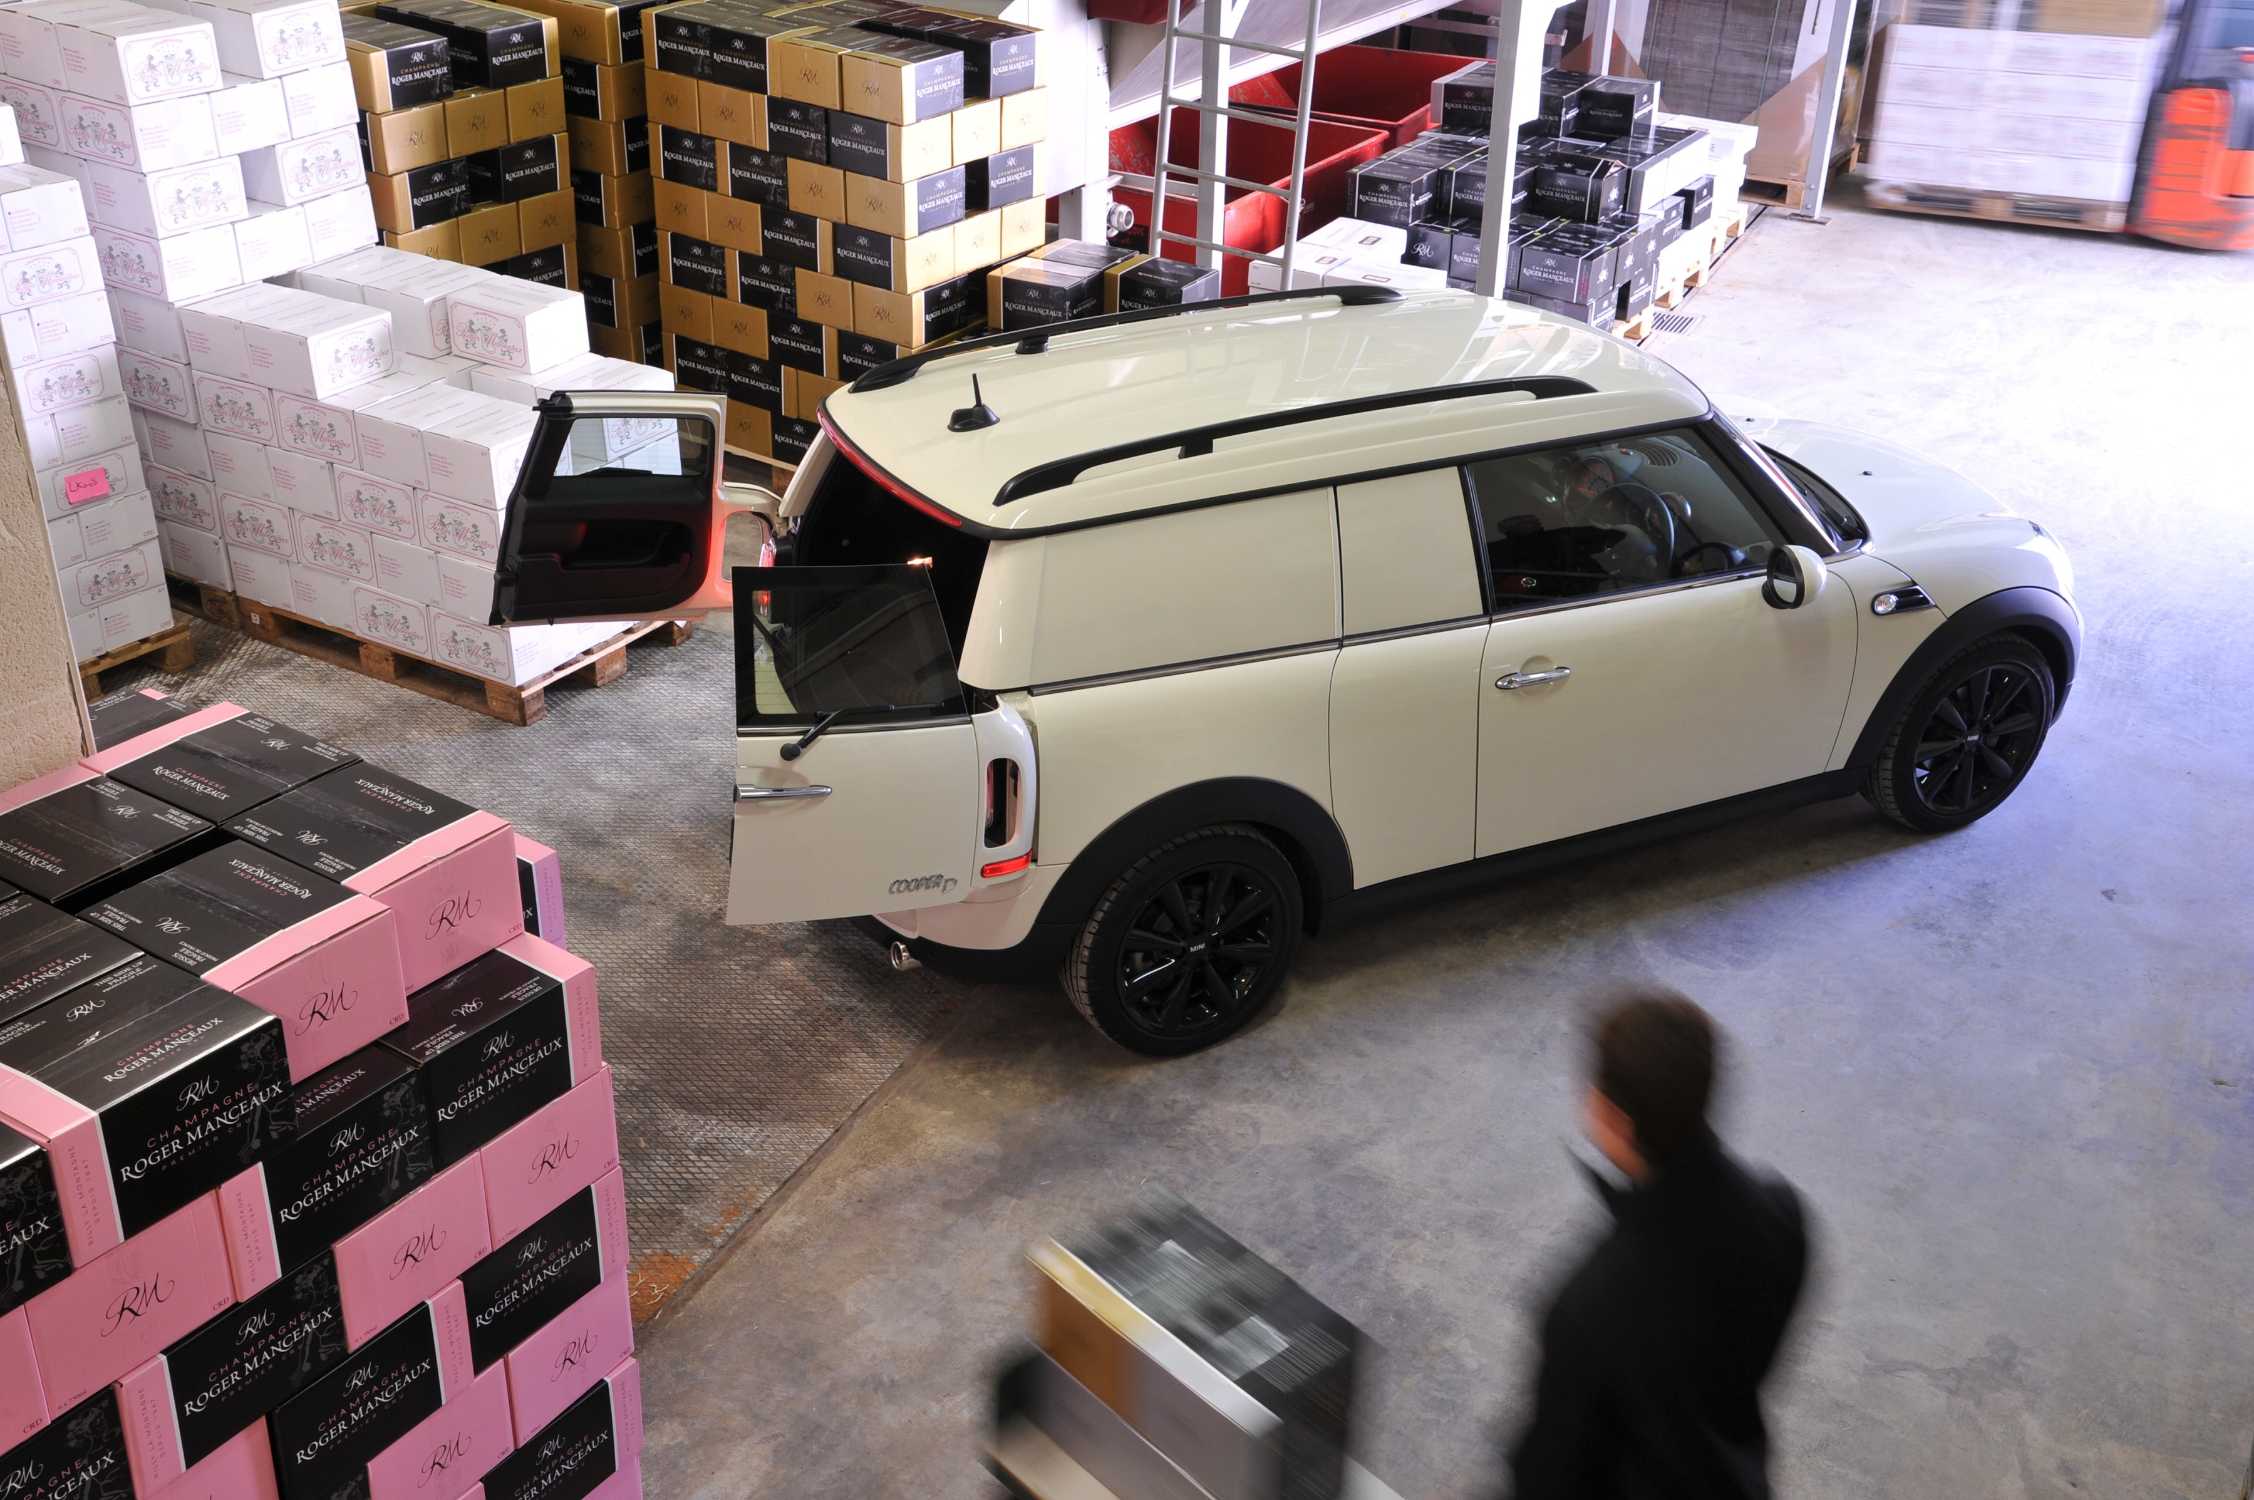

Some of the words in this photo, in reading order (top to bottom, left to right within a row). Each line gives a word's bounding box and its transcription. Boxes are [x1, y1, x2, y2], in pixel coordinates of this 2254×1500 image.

[492, 53, 511, 65] ROGER
[512, 48, 544, 60] MANCEAUX
[658, 40, 677, 49] ROGER
[678, 44, 710, 57] MANCEAUX
[714, 52, 732, 63] ROGER
[733, 57, 765, 70] MANCEAUX
[392, 73, 414, 86] ROGER
[415, 66, 448, 79] MANCEAUX
[770, 122, 788, 132] ROGER
[790, 128, 822, 140] MANCEAUX
[831, 137, 851, 147] ROGER
[852, 142, 885, 155] MANCEAUX
[506, 169, 523, 181] ROGER
[524, 163, 556, 176] MANCEAUX
[664, 151, 682, 161] ROGER
[683, 156, 714, 168] MANCEAUX
[732, 168, 750, 178] ROGER
[751, 173, 783, 186] MANCEAUX
[414, 192, 433, 206] ROGER
[434, 184, 466, 199] MANCEAUX
[1378, 198, 1408, 208] MANCEAUX
[1554, 192, 1584, 201] MANCEAUX
[764, 231, 783, 240] ROGER
[784, 236, 815, 249] MANCEAUX
[837, 248, 856, 259] ROGER
[857, 254, 889, 267] MANCEAUX
[673, 258, 691, 267] ROGER
[692, 262, 722, 275] MANCEAUX
[1523, 268, 1541, 277] ROGER
[1542, 272, 1574, 284] MANCEAUX
[742, 276, 759, 286] ROGER
[761, 281, 791, 294] MANCEAUX
[926, 310, 941, 321] ROGER
[942, 300, 966, 315] MANCEAUX
[1004, 301, 1026, 311] ROGER
[1027, 306, 1062, 318] MANCEAUX
[771, 335, 789, 346] ROGER
[791, 340, 821, 353] MANCEAUX
[843, 354, 862, 364] ROGER
[678, 358, 696, 368] ROGER
[697, 364, 726, 377] MANCEAUX
[731, 373, 749, 383] ROGER
[750, 379, 780, 393] MANCEAUX
[775, 434, 793, 444] ROGER
[153, 766, 184, 783] ROGER
[183, 777, 229, 800] MANCEAUX
[425, 890, 482, 940] RM
[17, 952, 92, 991] MANCEAUX
[295, 981, 358, 1036] RM
[103, 1057, 151, 1083] ROGER
[150, 1017, 224, 1058] MANCEAUX
[117, 1023, 195, 1066] CHAMPAGNE
[437, 1086, 485, 1122] ROGER
[487, 1037, 563, 1091] MANCEAUX
[458, 1039, 542, 1093] CHAMPAGNE
[176, 1075, 220, 1112] RM
[305, 1068, 366, 1107] MANCEAUX
[120, 1140, 184, 1183] ROGER
[187, 1081, 284, 1143] MANCEAUX
[146, 1082, 257, 1148] CHAMPAGNE
[328, 1122, 364, 1157] RM
[279, 1183, 333, 1224] ROGER
[336, 1126, 420, 1183] MANCEAUX
[302, 1128, 398, 1192] CHAMPAGNE
[528, 1132, 581, 1184] RM
[0, 1217, 50, 1255] EAUX
[390, 1224, 447, 1280] RM
[475, 1290, 520, 1329] ROGER
[522, 1238, 593, 1290] MANCEAUX
[494, 1240, 572, 1299] CHAMPAGNE
[100, 1272, 176, 1337] RM
[236, 1308, 275, 1345] RM
[184, 1372, 240, 1416] ROGER
[244, 1307, 333, 1376] MANCEAUX
[208, 1311, 307, 1382] CHAMPAGNE
[296, 1421, 348, 1465] ROGER
[350, 1358, 431, 1424] MANCEAUX
[318, 1363, 409, 1432] CHAMPAGNE
[417, 1431, 472, 1488] RM
[540, 1429, 609, 1491] MANCEAUX
